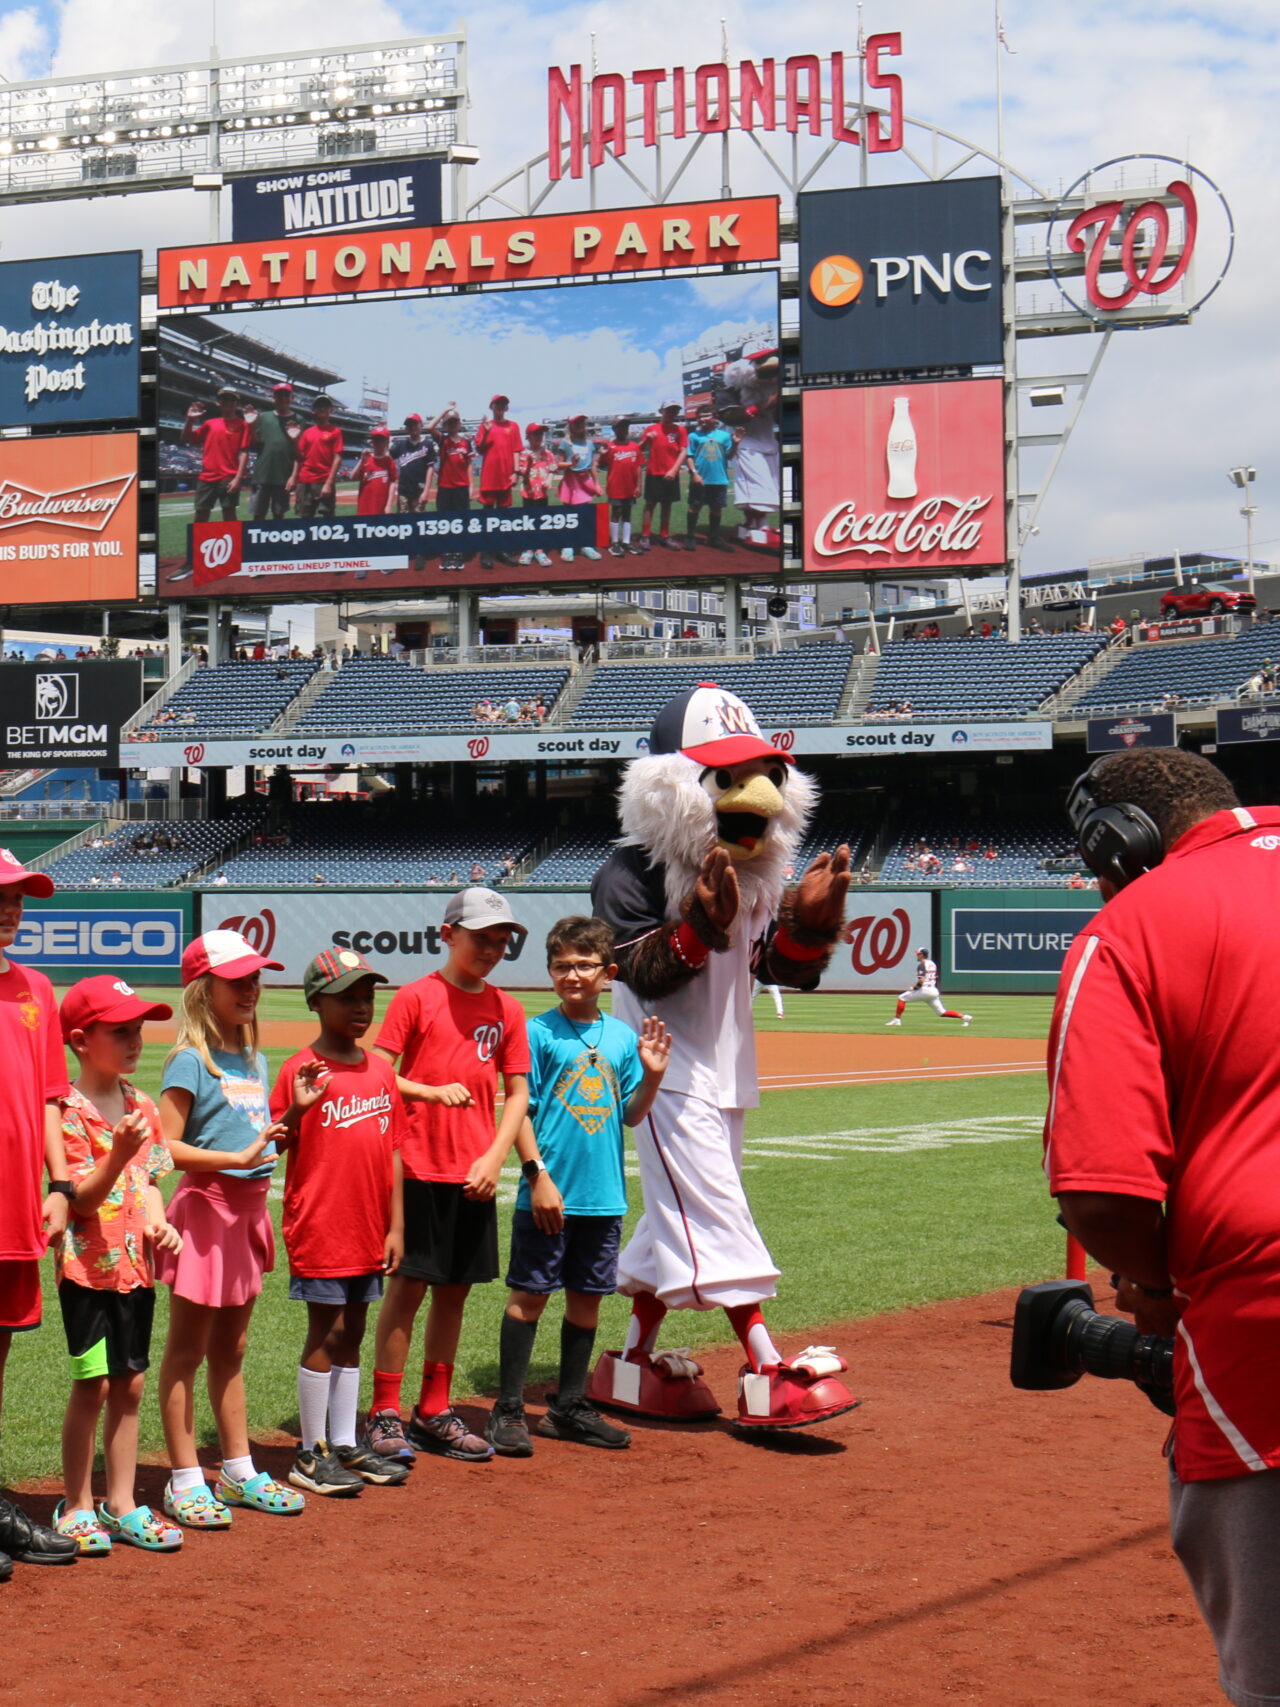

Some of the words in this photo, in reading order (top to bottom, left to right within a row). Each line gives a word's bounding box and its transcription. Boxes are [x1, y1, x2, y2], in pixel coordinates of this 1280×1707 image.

[548, 31, 903, 181] NATIONALS
[256, 175, 303, 194] SHOW
[306, 170, 351, 189] SOME
[283, 175, 415, 231] NATITUDE
[179, 231, 536, 291] NATIONALS
[574, 214, 741, 258] PARK
[1066, 180, 1197, 311] W
[870, 250, 992, 298] PNC
[31, 281, 80, 312] The
[24, 361, 87, 402] Post
[248, 528, 306, 544] Troop
[310, 524, 349, 542] 102,
[353, 523, 413, 540] Troop
[417, 519, 463, 536] 1396
[467, 518, 482, 533] &
[486, 515, 535, 533] Pack
[539, 513, 579, 530] 295
[814, 494, 992, 557] Coca-Cola
[19, 544, 60, 560] BUD'S
[63, 543, 90, 558] FOR
[92, 541, 123, 558] YOU.
[200, 534, 233, 568] W
[248, 563, 295, 573] STARTING
[297, 562, 330, 571] LINEUP
[333, 561, 371, 570] TUNNEL
[6, 725, 108, 745] BETMGM
[467, 736, 489, 759] W
[537, 738, 584, 752] scout
[589, 737, 620, 753] day
[846, 733, 897, 746] scout
[901, 731, 935, 747] day
[42, 750, 52, 758] OF
[53, 749, 107, 757] SPORTSBOOKS
[184, 743, 205, 765] W
[249, 746, 293, 758] scout
[297, 744, 327, 760] day
[4, 921, 175, 956] GEICO
[332, 926, 439, 954] scout
[846, 908, 911, 975] W
[966, 933, 1073, 950] VENTURE
[473, 1021, 505, 1063] W
[321, 1088, 391, 1128] Nationals
